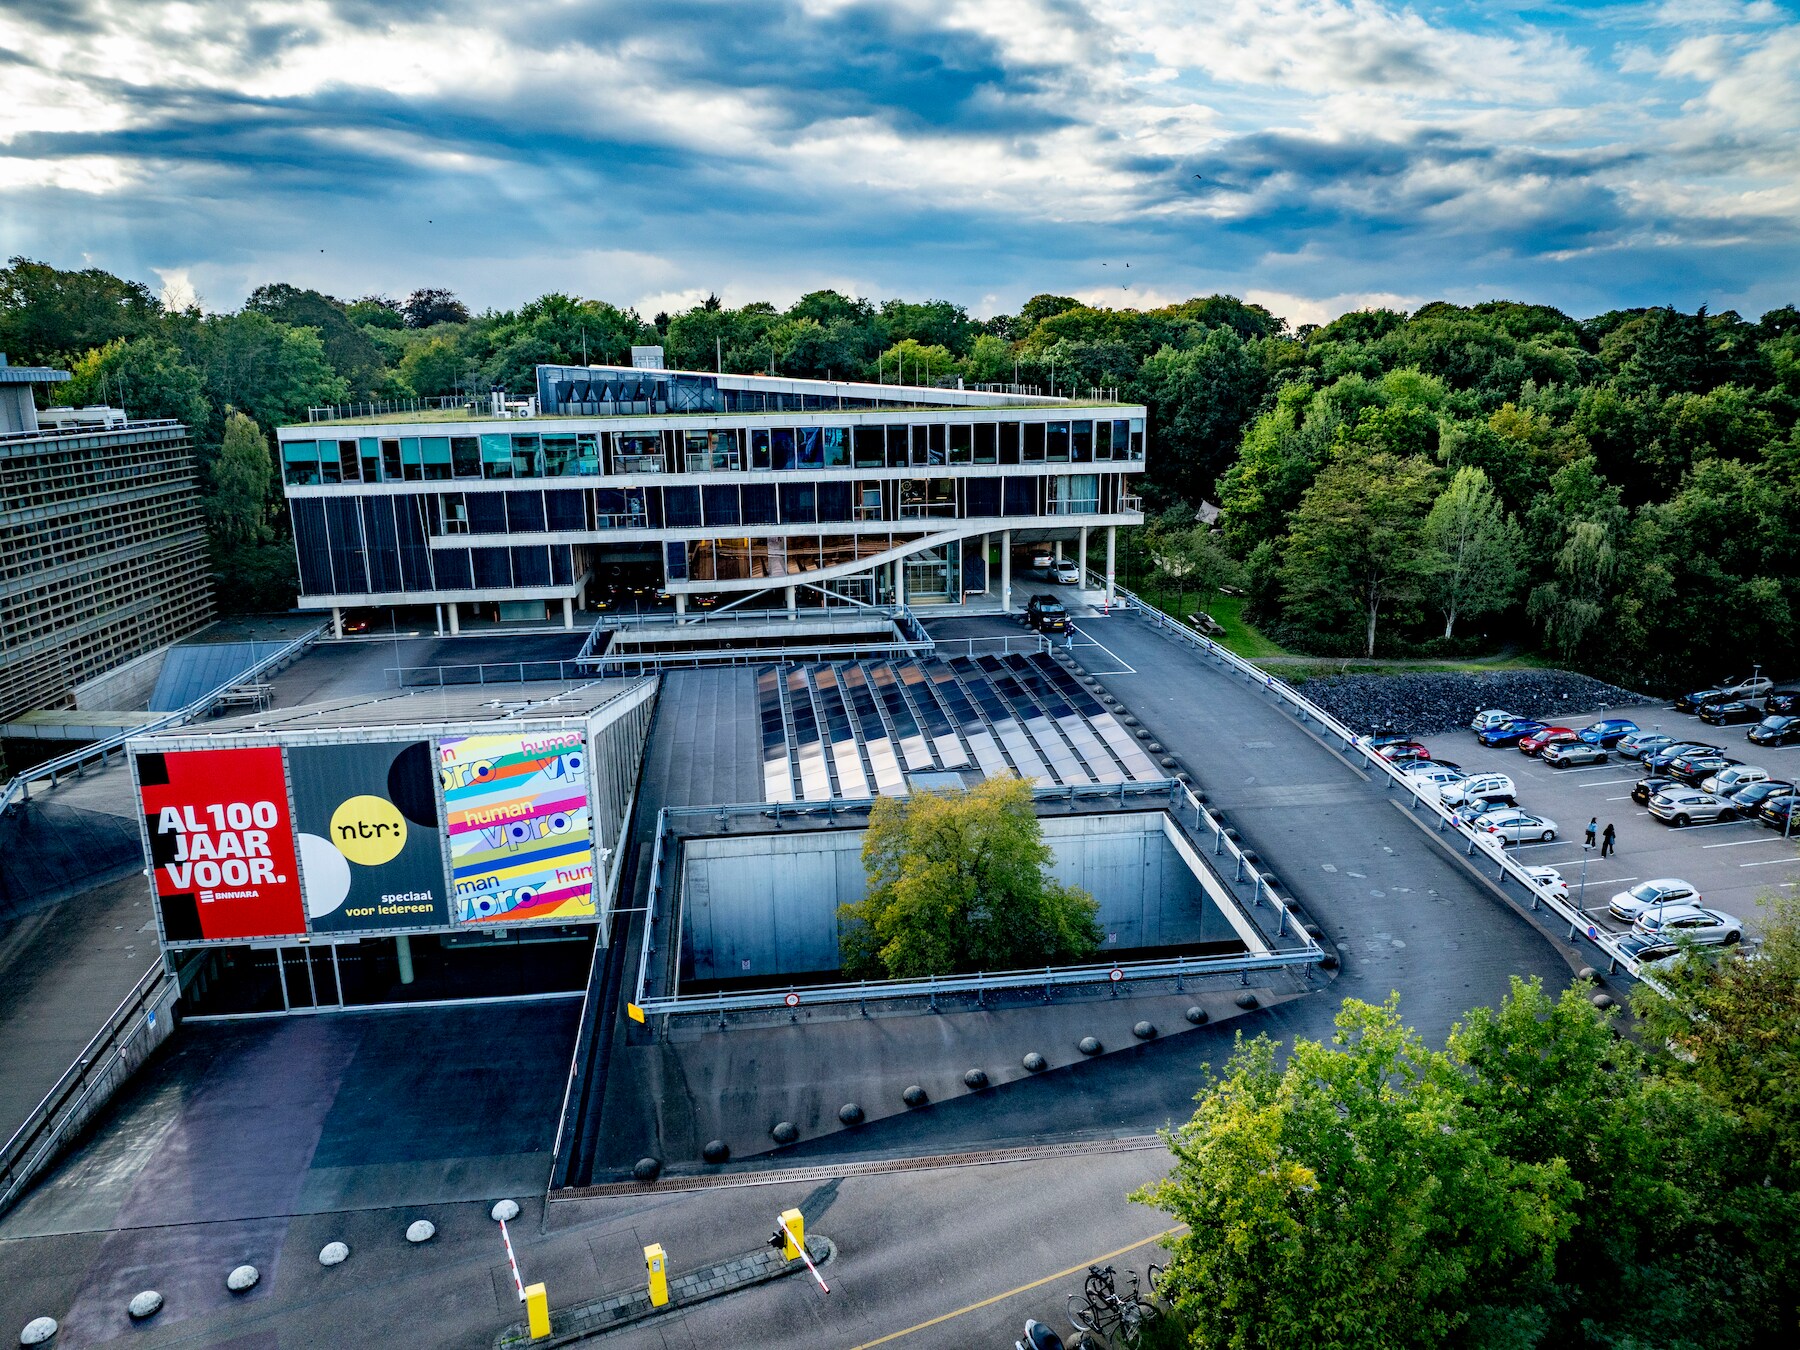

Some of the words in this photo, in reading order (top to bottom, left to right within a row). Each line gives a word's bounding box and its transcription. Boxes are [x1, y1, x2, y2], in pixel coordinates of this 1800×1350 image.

[158, 806, 207, 834] AL
[207, 801, 278, 831] 100
[464, 801, 534, 827] human
[338, 820, 400, 839] ntr:
[480, 809, 574, 852] vpro
[174, 830, 272, 862] JAAR
[165, 858, 286, 889] VOOR.
[215, 890, 259, 900] BNNVARA
[456, 876, 500, 894] man
[381, 890, 433, 904] speciaal
[345, 905, 376, 917] voor
[378, 903, 434, 916] iedereen
